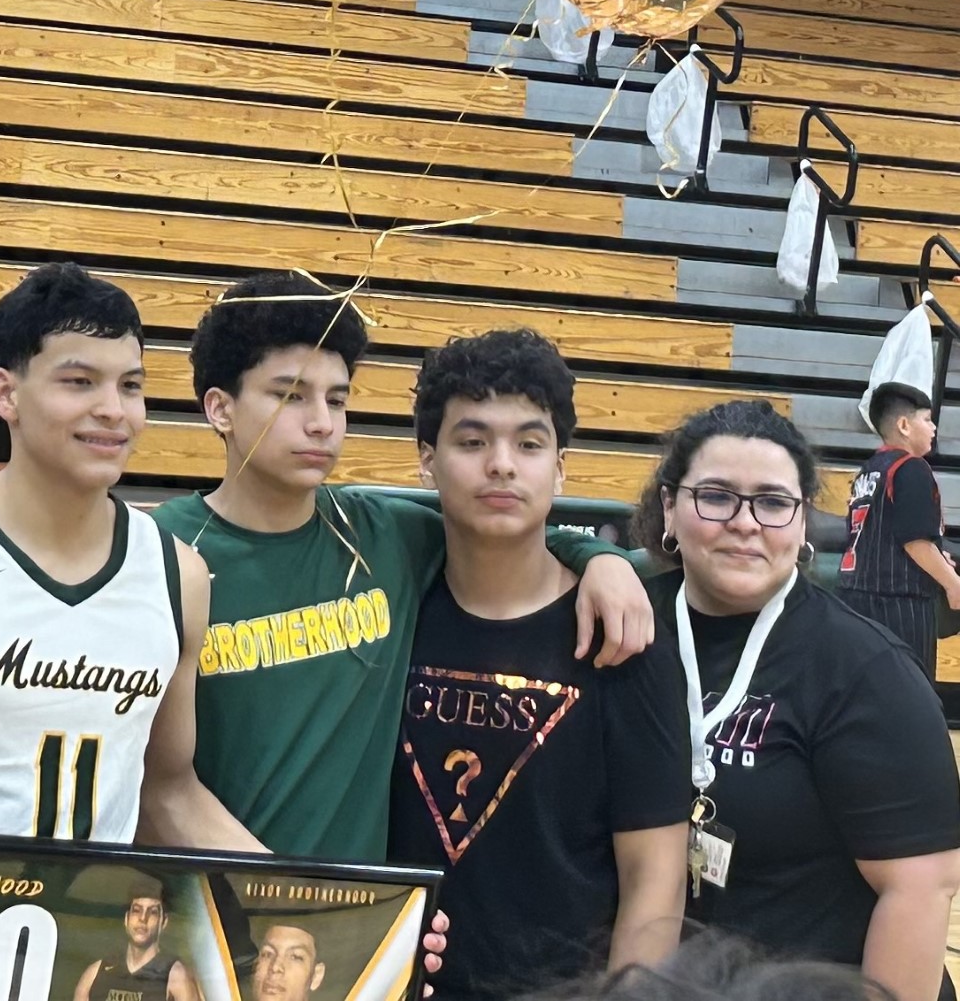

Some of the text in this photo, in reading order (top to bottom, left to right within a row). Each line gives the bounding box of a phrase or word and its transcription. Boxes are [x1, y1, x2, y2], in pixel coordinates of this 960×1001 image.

[198, 588, 391, 677] BROTHERHOOD
[405, 682, 537, 732] GUESS
[32, 730, 103, 841] 11
